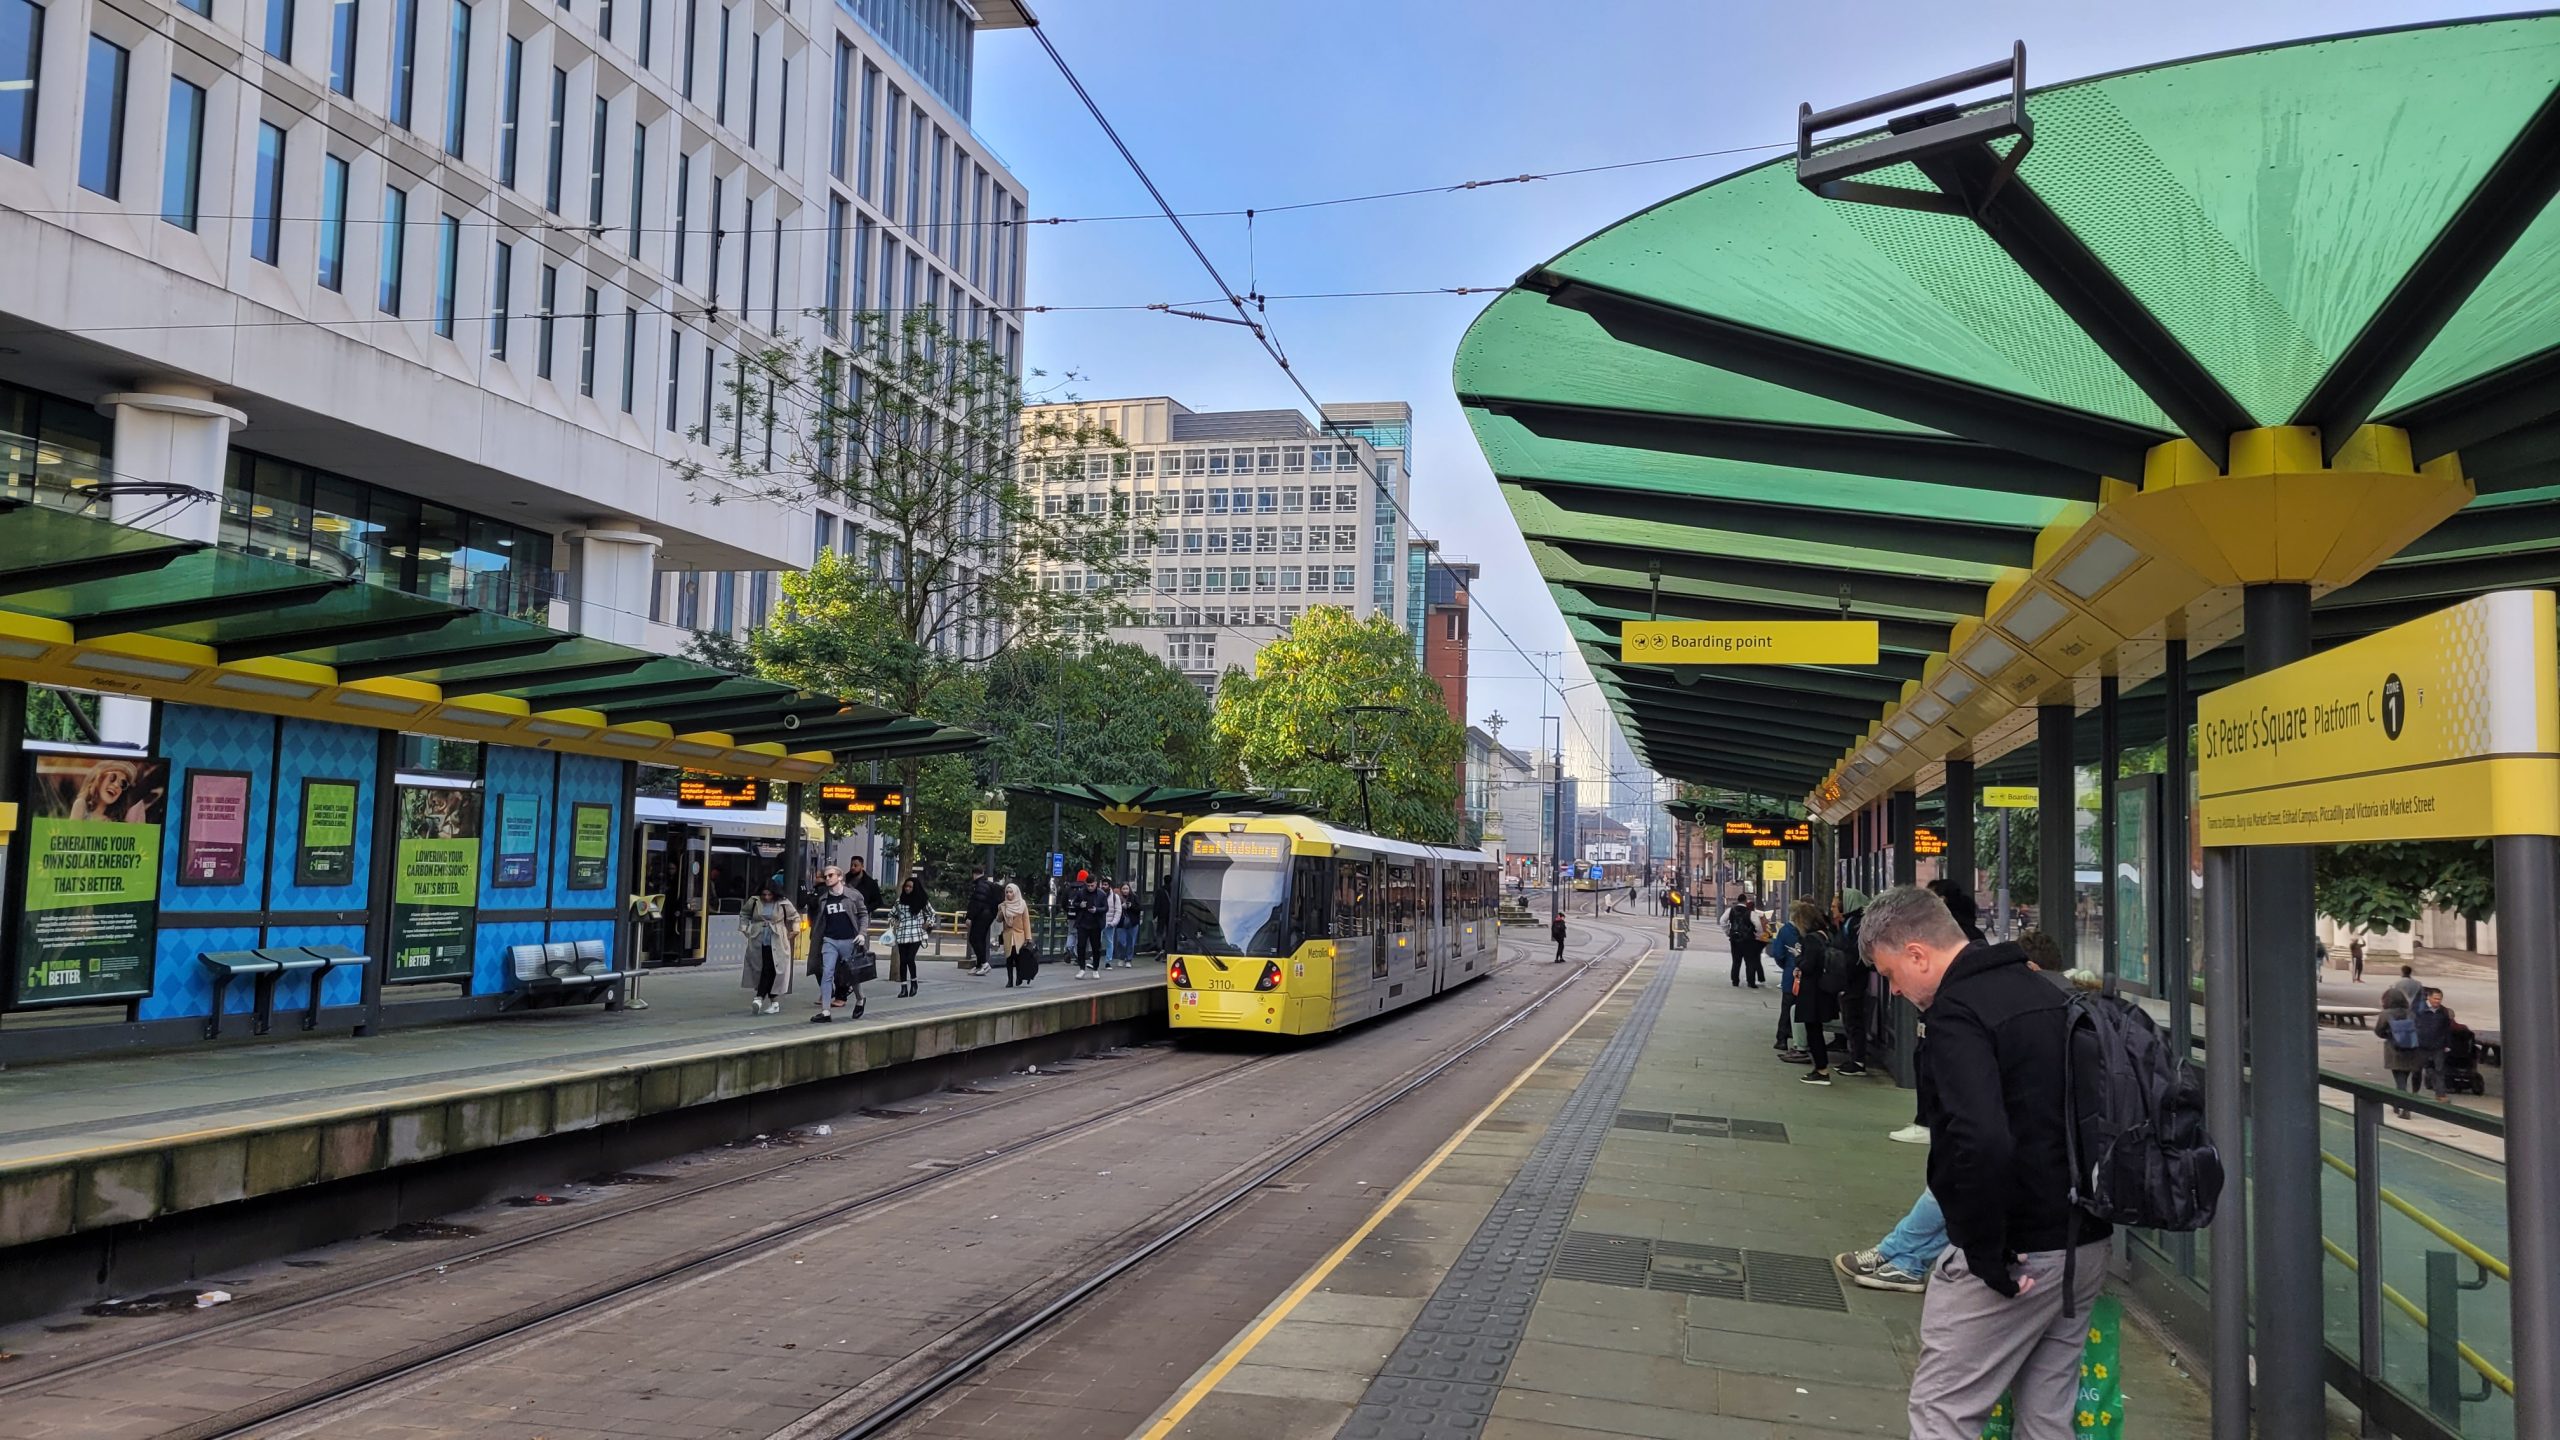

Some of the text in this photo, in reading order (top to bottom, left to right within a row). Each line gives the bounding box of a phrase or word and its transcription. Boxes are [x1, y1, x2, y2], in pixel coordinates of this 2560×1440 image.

[1671, 635, 1773, 651] Boarding point
[2386, 681, 2400, 694] ZONE
[2388, 696, 2397, 732] 1
[2206, 690, 2376, 759] St Peter's Square Platform C
[2008, 793, 2038, 802] Boarding
[2319, 805, 2344, 825] Piccadilly
[2345, 804, 2355, 820] and
[2356, 801, 2378, 819] Victoria
[2379, 800, 2388, 816] via
[2389, 797, 2412, 815] Market
[2413, 795, 2435, 813] Street
[50, 835, 135, 851] GENERATING YOUR
[1193, 840, 1221, 854] East
[42, 854, 142, 869] OWN SOLAR ENERGY?
[415, 850, 463, 863] LOWERING YOUR
[407, 864, 469, 877] CARBON EMISSIONS?
[54, 876, 125, 893] THAT'S BETTER.
[414, 882, 436, 895] THAT'S
[408, 955, 431, 967] BETTER
[48, 969, 81, 986] BETTER
[1208, 979, 1231, 990] 3110
[2080, 1387, 2099, 1401] AG
